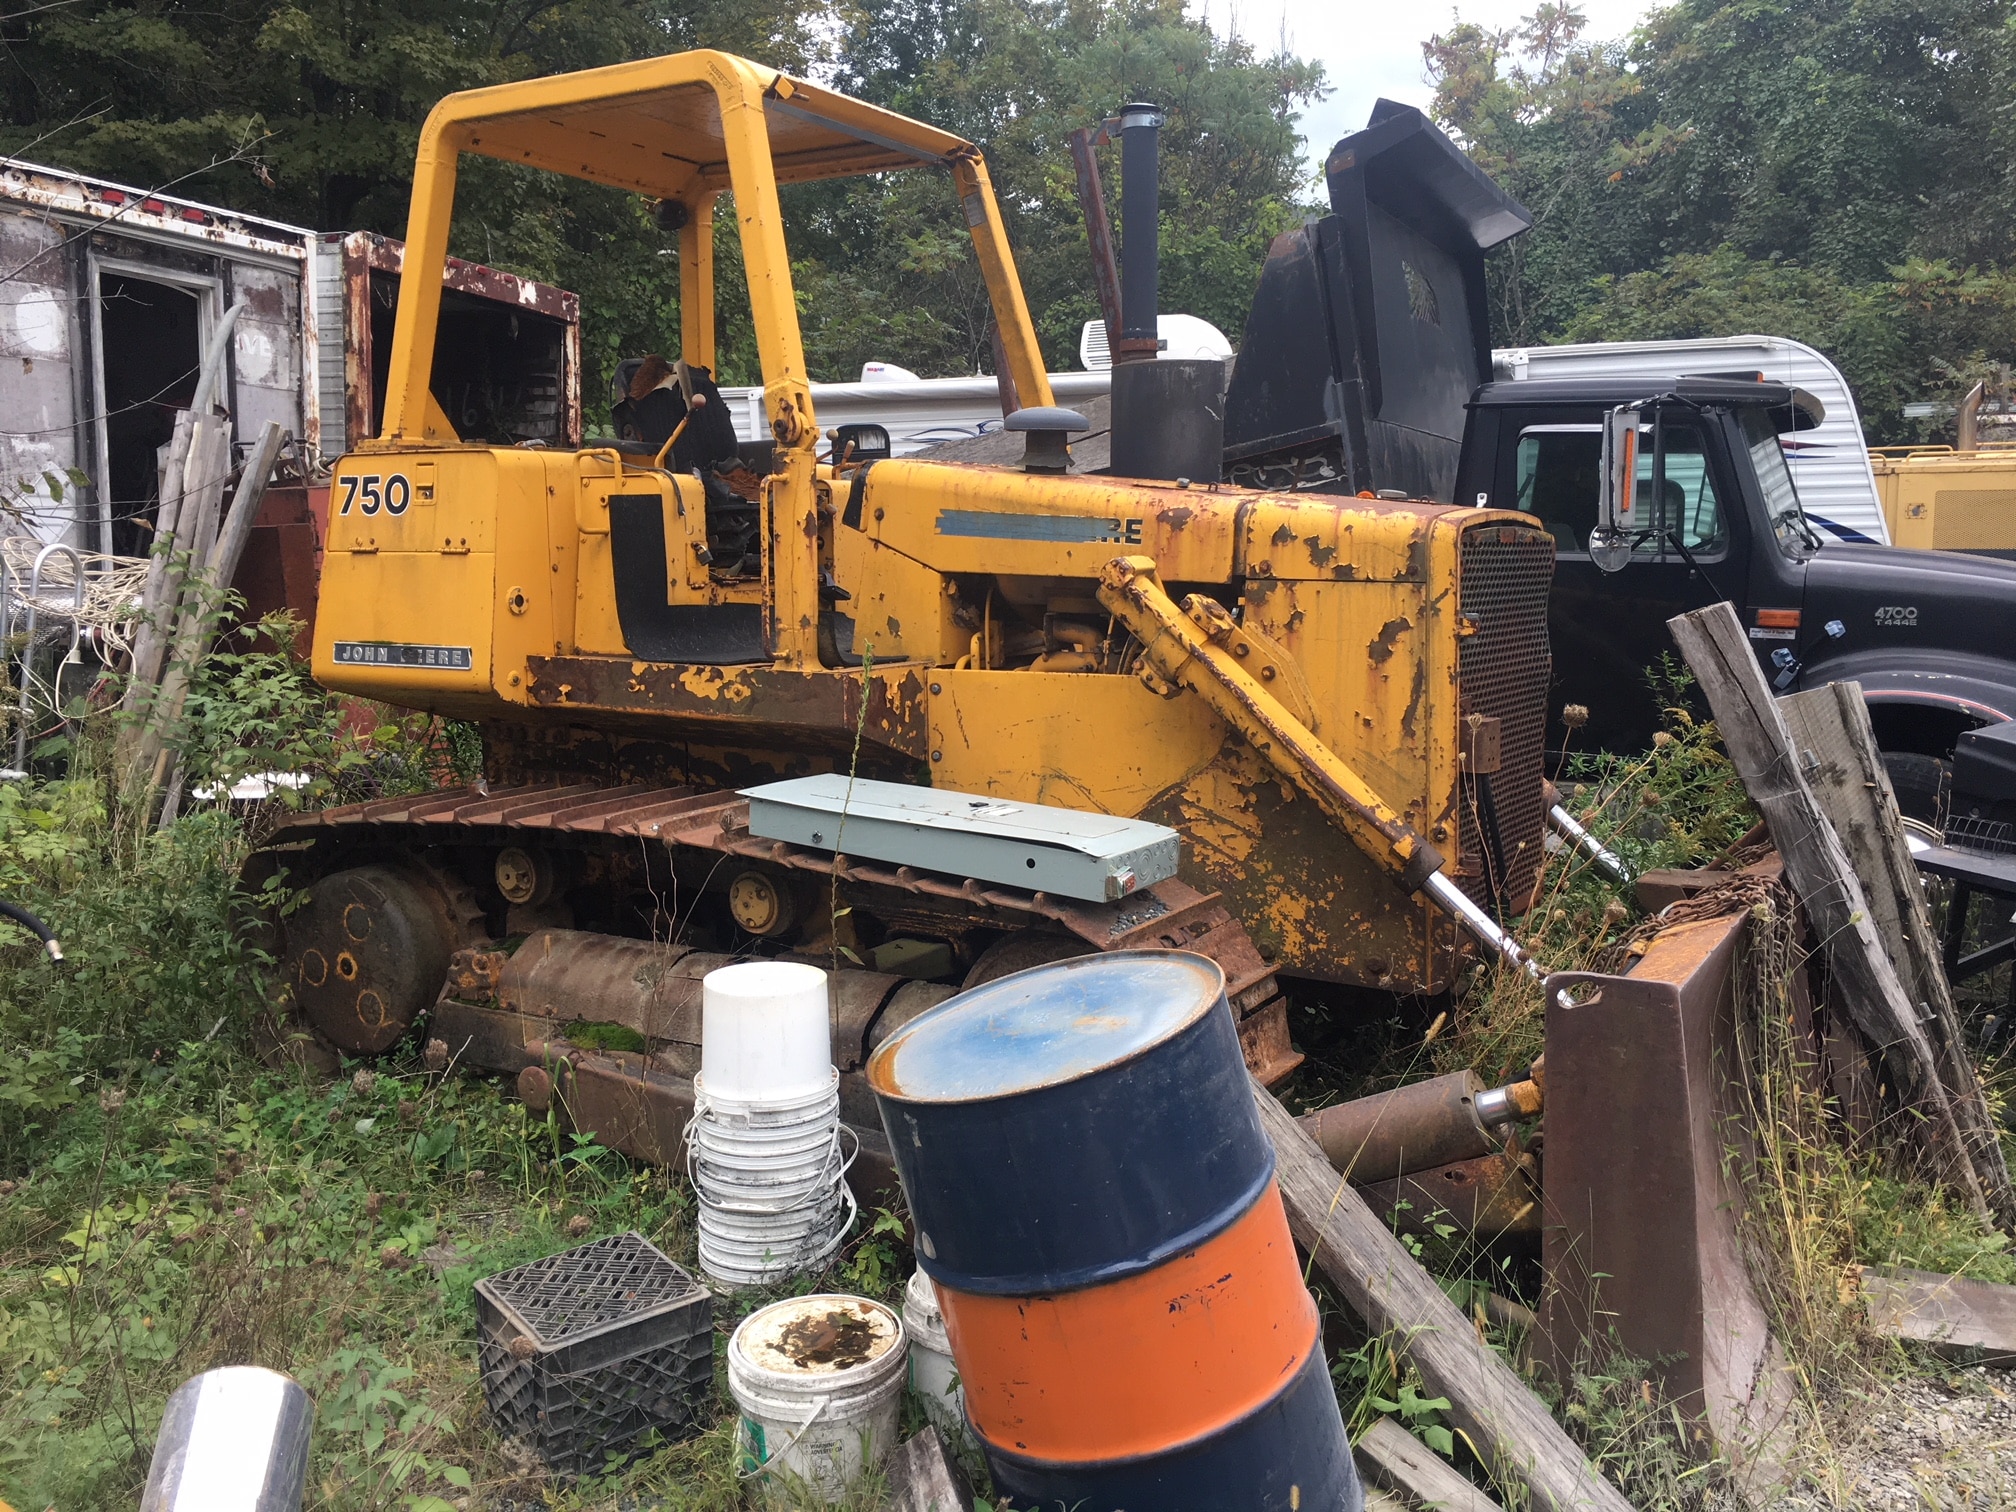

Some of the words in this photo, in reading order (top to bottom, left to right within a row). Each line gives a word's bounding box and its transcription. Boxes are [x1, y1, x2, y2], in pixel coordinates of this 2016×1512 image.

[338, 472, 411, 516] 750
[1874, 606, 1918, 619] 4700
[1884, 618, 1918, 626] 444E
[342, 646, 388, 662] JOHN
[400, 648, 462, 665] ERE
